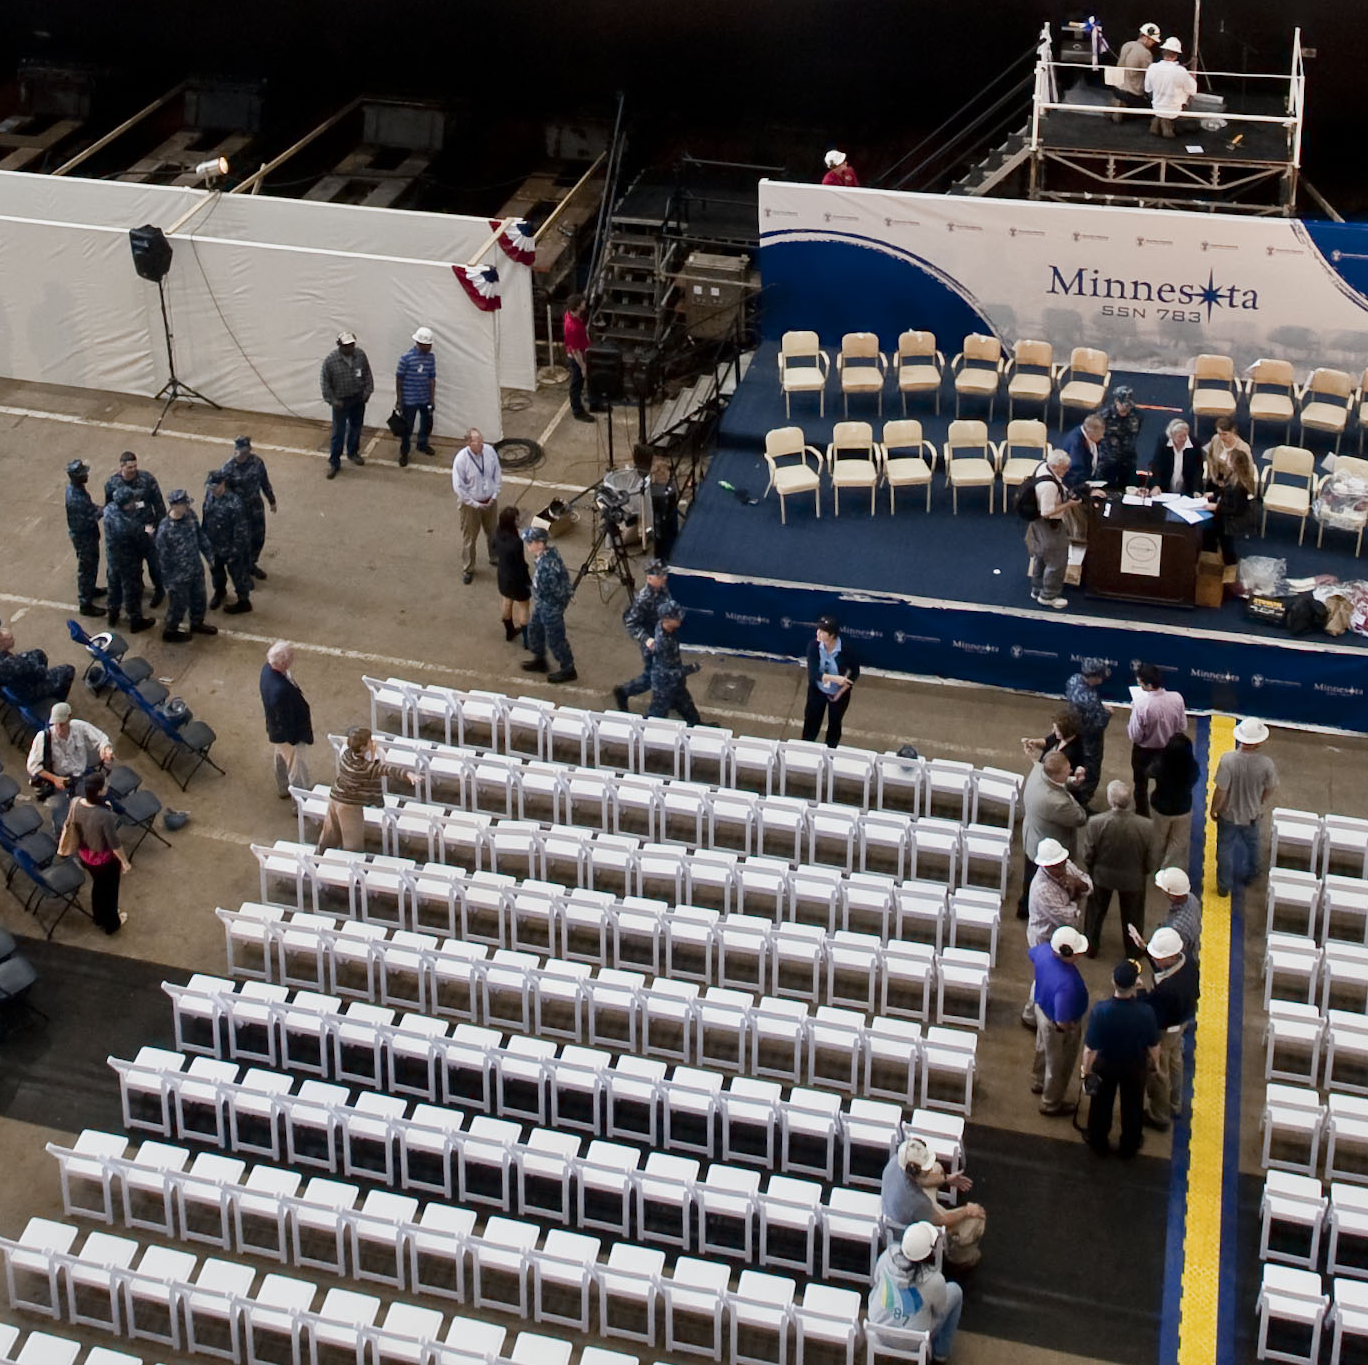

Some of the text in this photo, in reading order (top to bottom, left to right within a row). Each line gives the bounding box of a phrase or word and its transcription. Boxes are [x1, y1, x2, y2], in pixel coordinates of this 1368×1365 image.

[1101, 305, 1202, 324] SSN 783
[893, 1307, 910, 1326] 87
